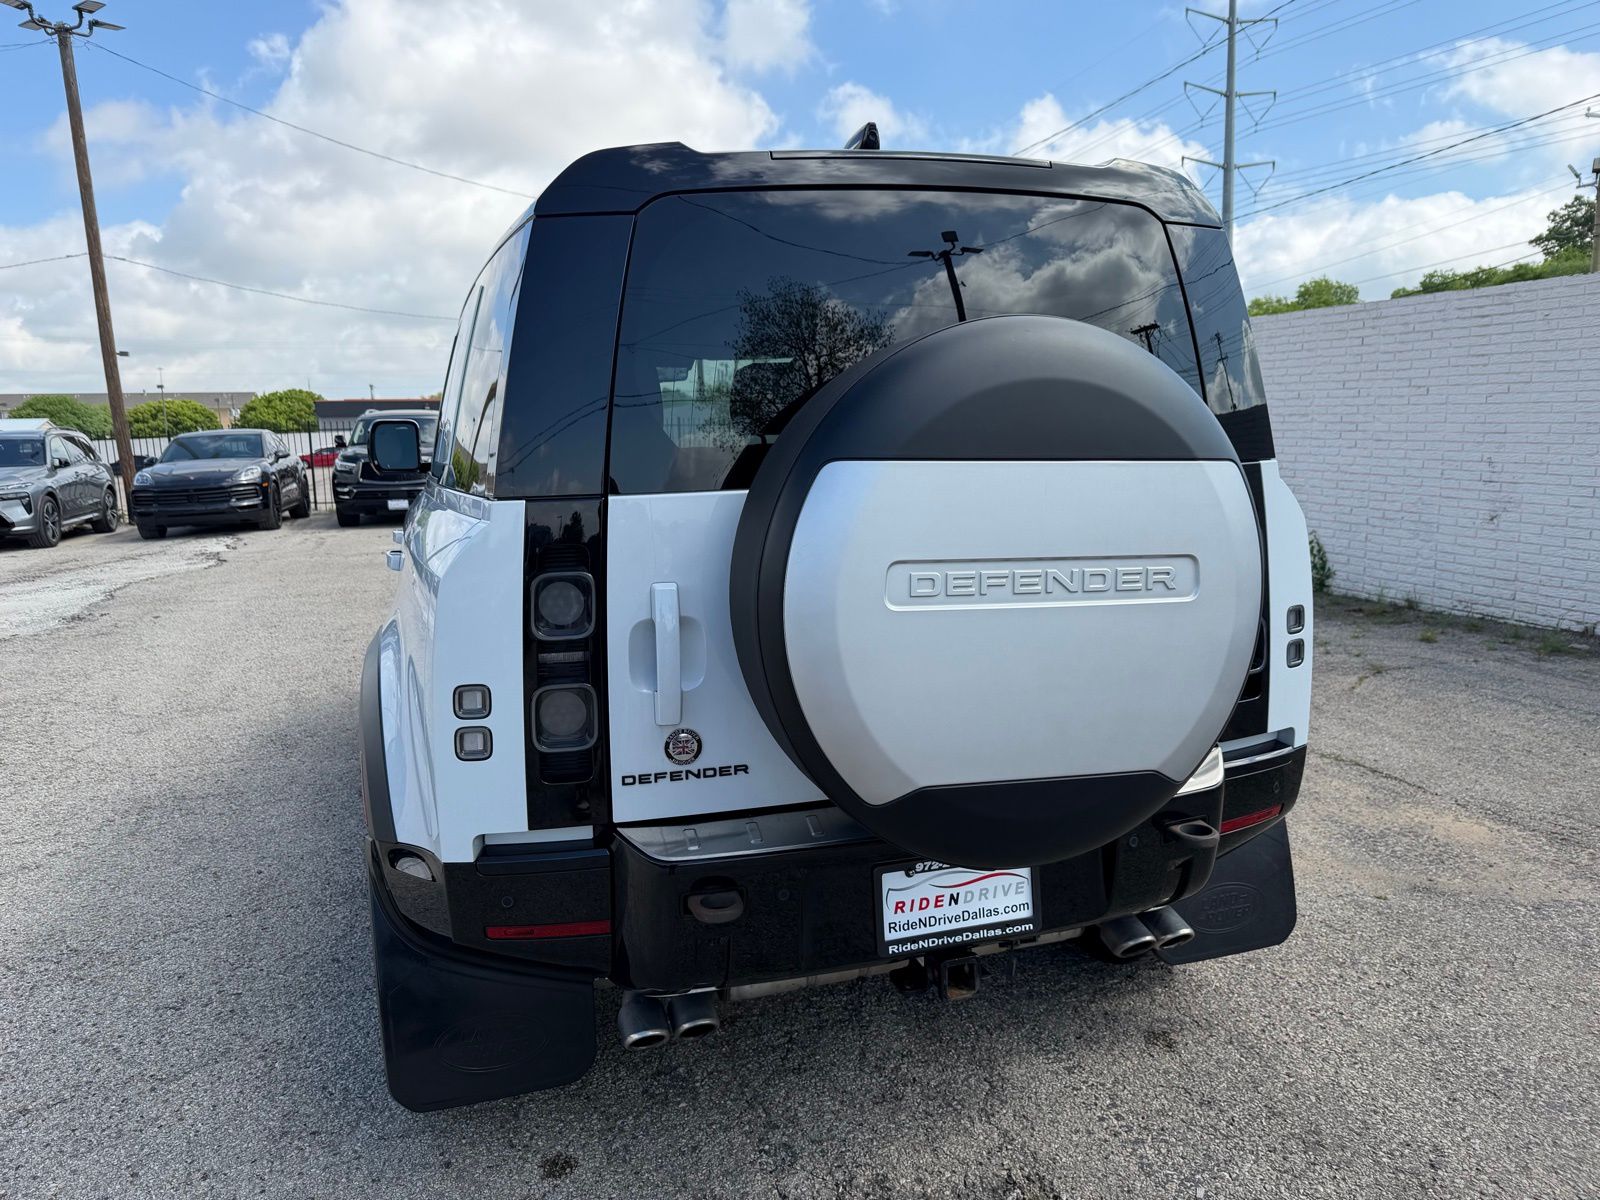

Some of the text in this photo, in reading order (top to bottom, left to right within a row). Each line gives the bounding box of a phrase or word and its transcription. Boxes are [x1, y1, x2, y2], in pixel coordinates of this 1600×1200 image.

[909, 566, 1176, 597] DEFENDER
[621, 764, 750, 786] DEFENDER
[888, 901, 1030, 934] RideNDriveDallas.com
[888, 922, 1034, 955] RideNDriveDallas.com
